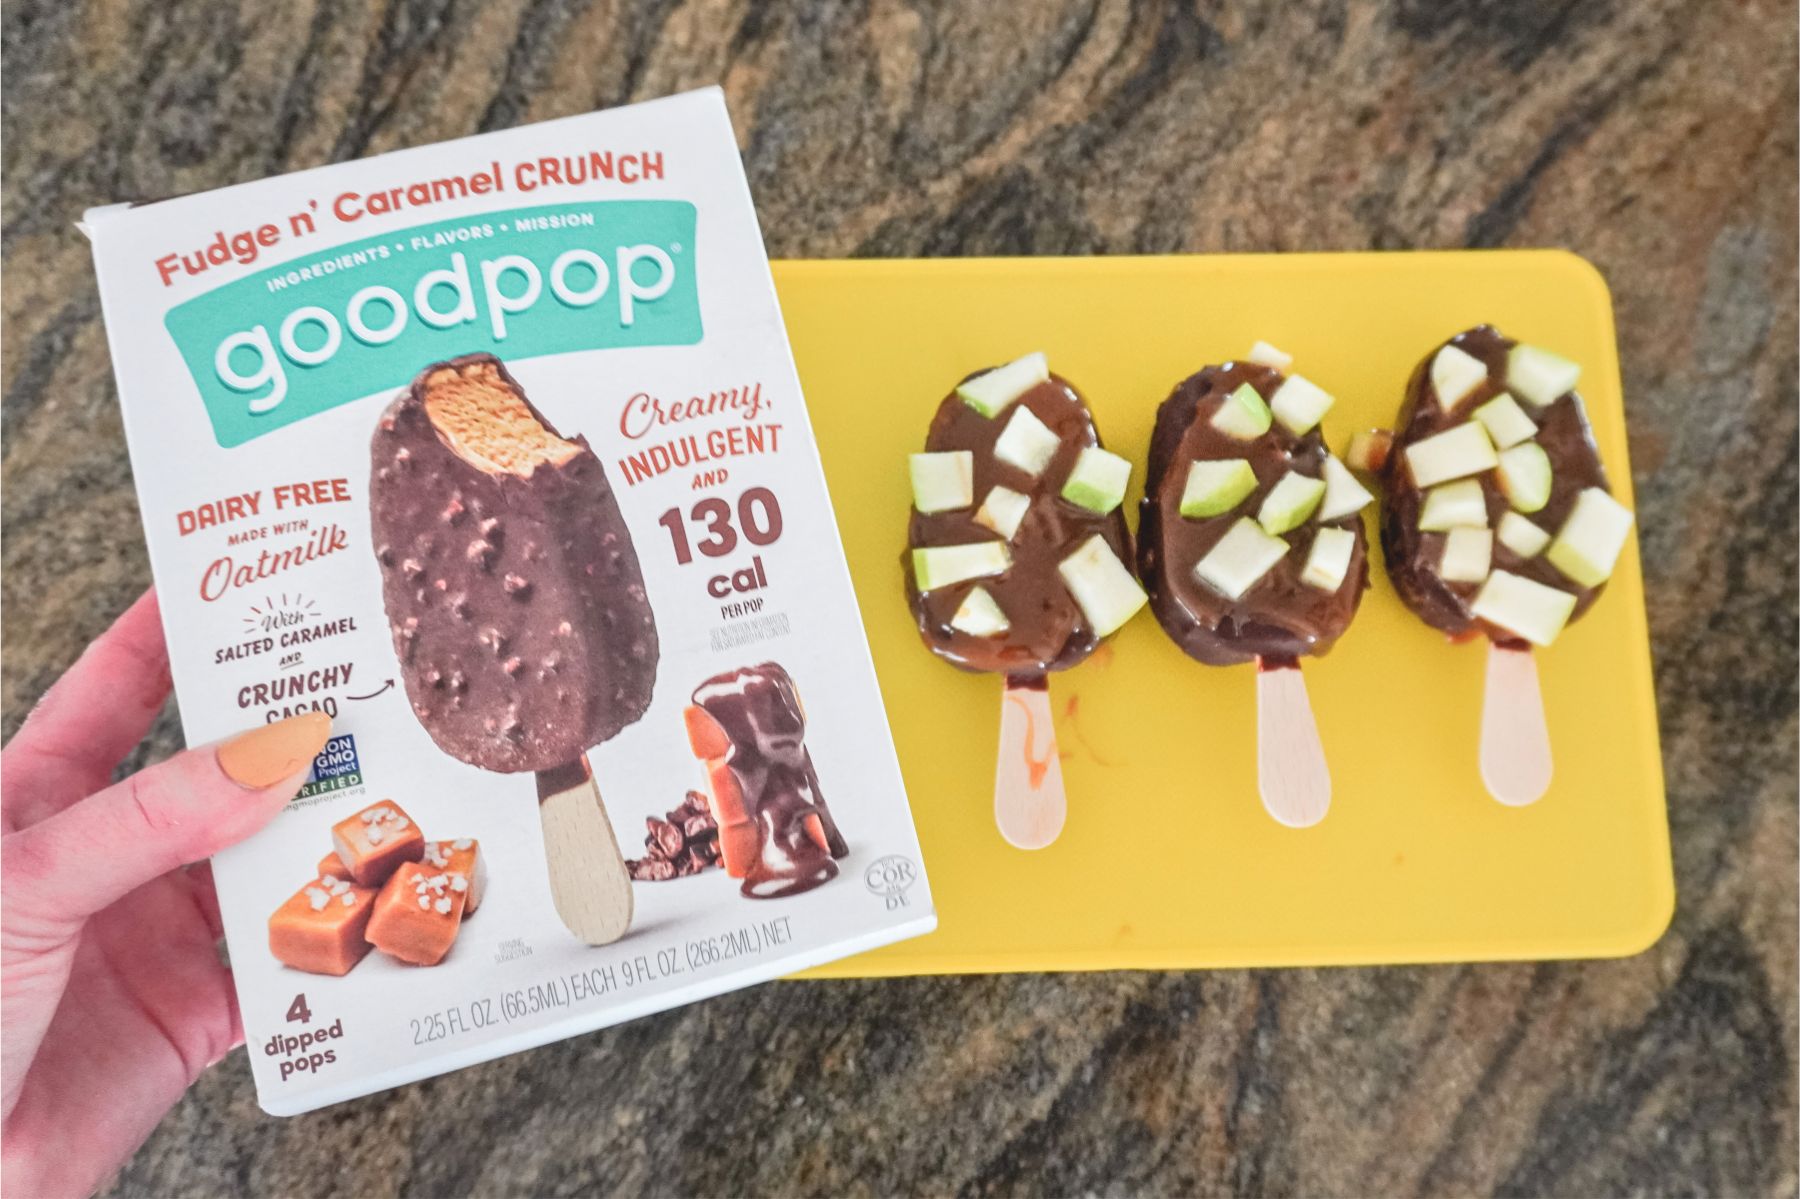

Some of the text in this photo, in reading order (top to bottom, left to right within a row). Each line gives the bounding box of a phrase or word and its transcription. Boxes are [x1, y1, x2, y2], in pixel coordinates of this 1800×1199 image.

[154, 223, 281, 287] Fudge
[332, 161, 504, 222] Caramel
[514, 151, 665, 192] CRUNCH
[266, 212, 595, 292] INGREDIENTS FLAVORS MISSION
[213, 242, 676, 413] goodpop
[619, 382, 772, 440] Creamy,
[618, 424, 782, 487] INDULGENT
[691, 468, 729, 490] AND
[177, 478, 352, 537] DAIRY FREE
[658, 486, 783, 565] 130
[228, 519, 309, 546] MADE WITH
[200, 524, 349, 602] Oatmilk
[707, 555, 768, 598] cal
[261, 611, 304, 632] With
[721, 597, 763, 620] PER POP
[215, 617, 357, 664] SALTED CARAMEL
[280, 652, 302, 666] AND
[238, 663, 353, 708] CRUNCHY
[316, 749, 355, 768] GMO
[318, 761, 357, 778] Project
[293, 774, 360, 799] RIFIED
[410, 915, 794, 1045] 2.25 FL OZ. (66.5ML) EACH 9 FL OZ. (266.2ML) NET
[285, 993, 312, 1024] 4
[264, 1018, 344, 1057] dipped
[279, 1049, 337, 1081] pops
